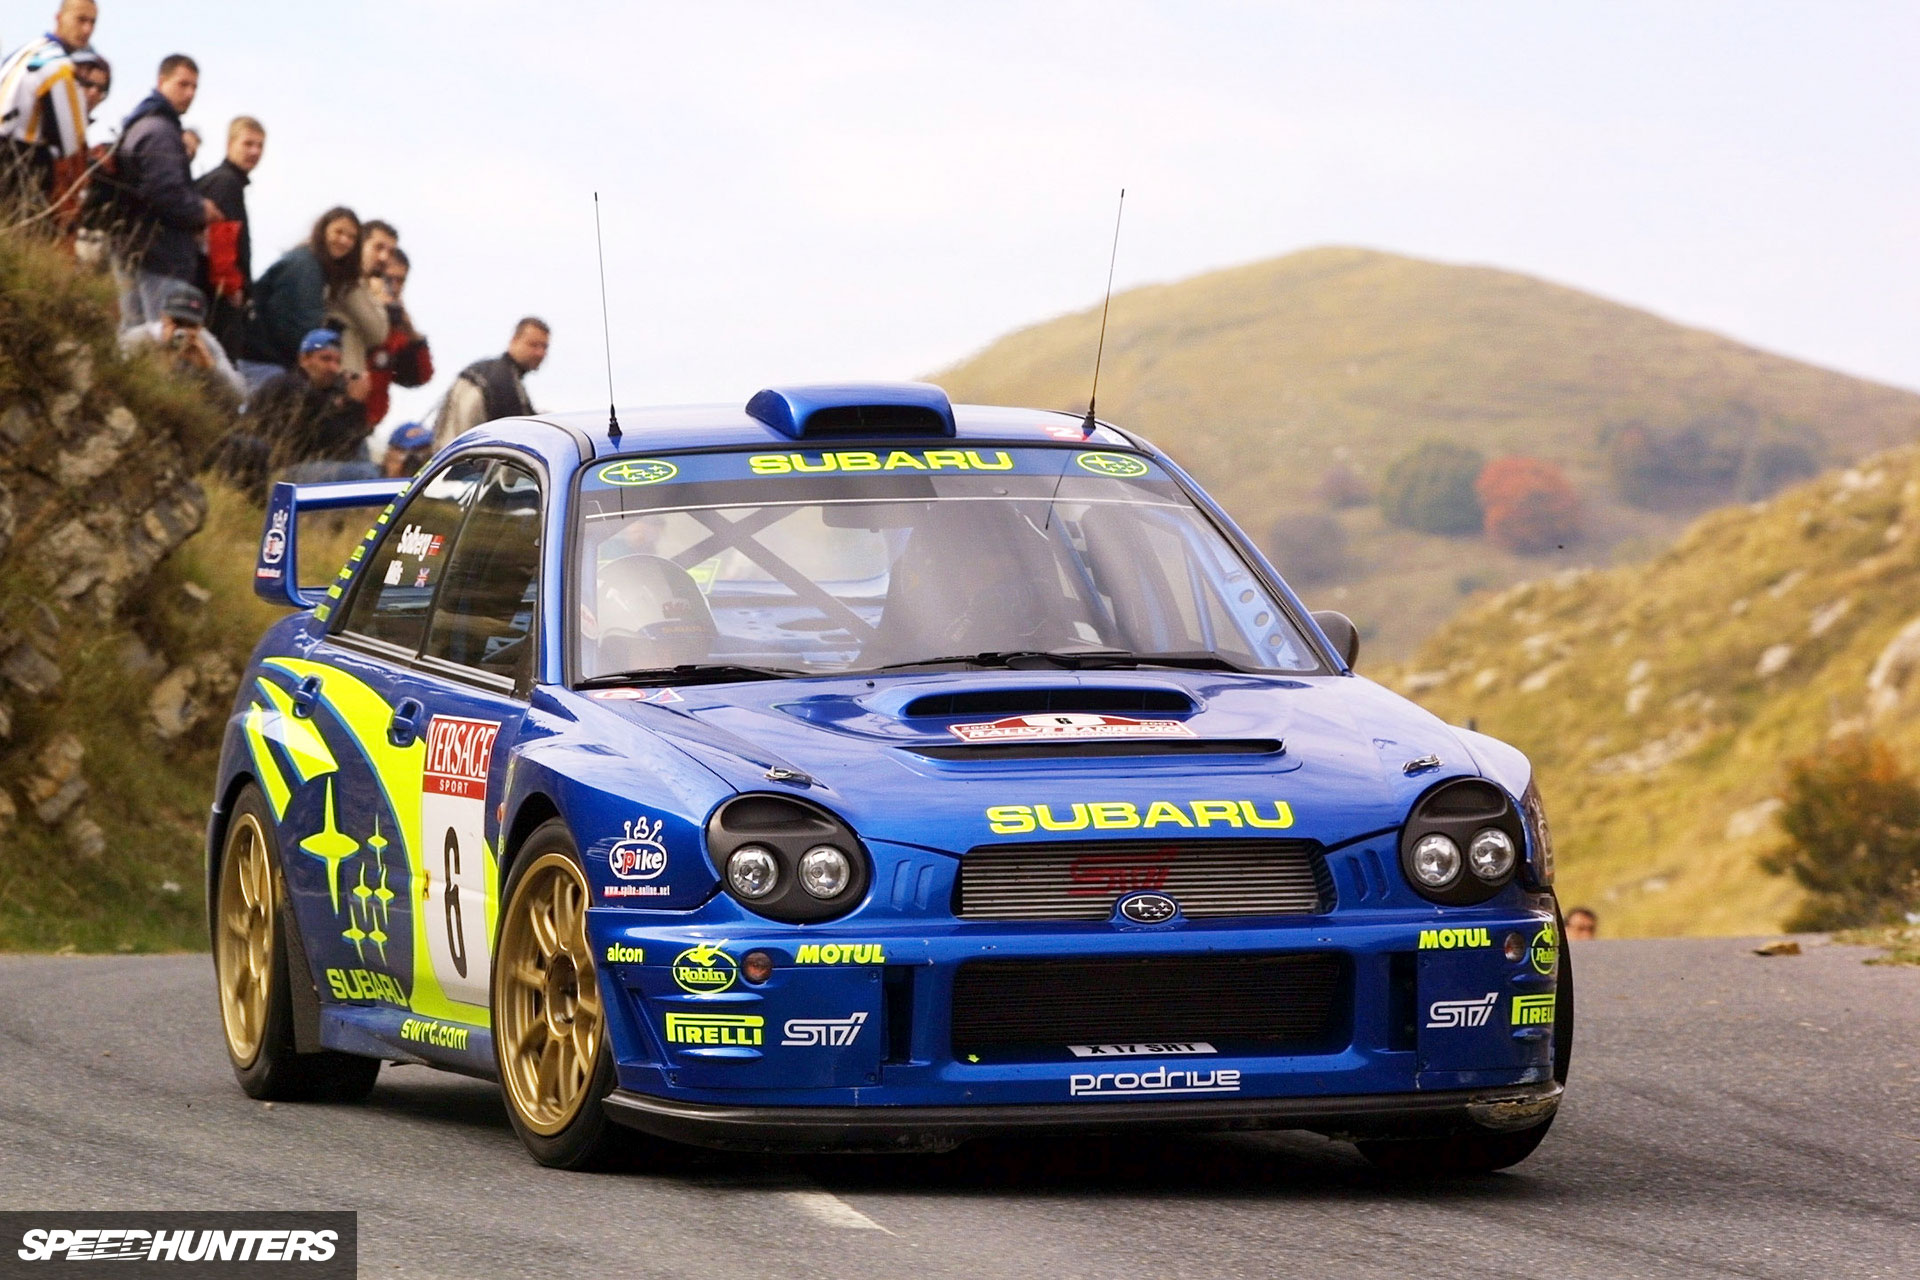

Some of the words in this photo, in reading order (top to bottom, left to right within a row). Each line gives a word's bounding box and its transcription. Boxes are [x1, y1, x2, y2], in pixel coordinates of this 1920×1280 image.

[749, 451, 1014, 475] SUBARU
[426, 720, 497, 778] VERSACE
[439, 779, 469, 794] SPORT
[986, 801, 1295, 834] SUBARU
[613, 847, 663, 875] Spike
[444, 826, 467, 979] 6
[607, 943, 643, 963] alcon
[1418, 928, 1492, 949] MOTUL
[795, 944, 886, 964] MOTUL
[326, 968, 409, 1007] SUBARU
[678, 965, 729, 984] Robin
[401, 1018, 470, 1050] swrt.com
[665, 1012, 765, 1045] PIRELLI
[1070, 1066, 1241, 1096] prodrive
